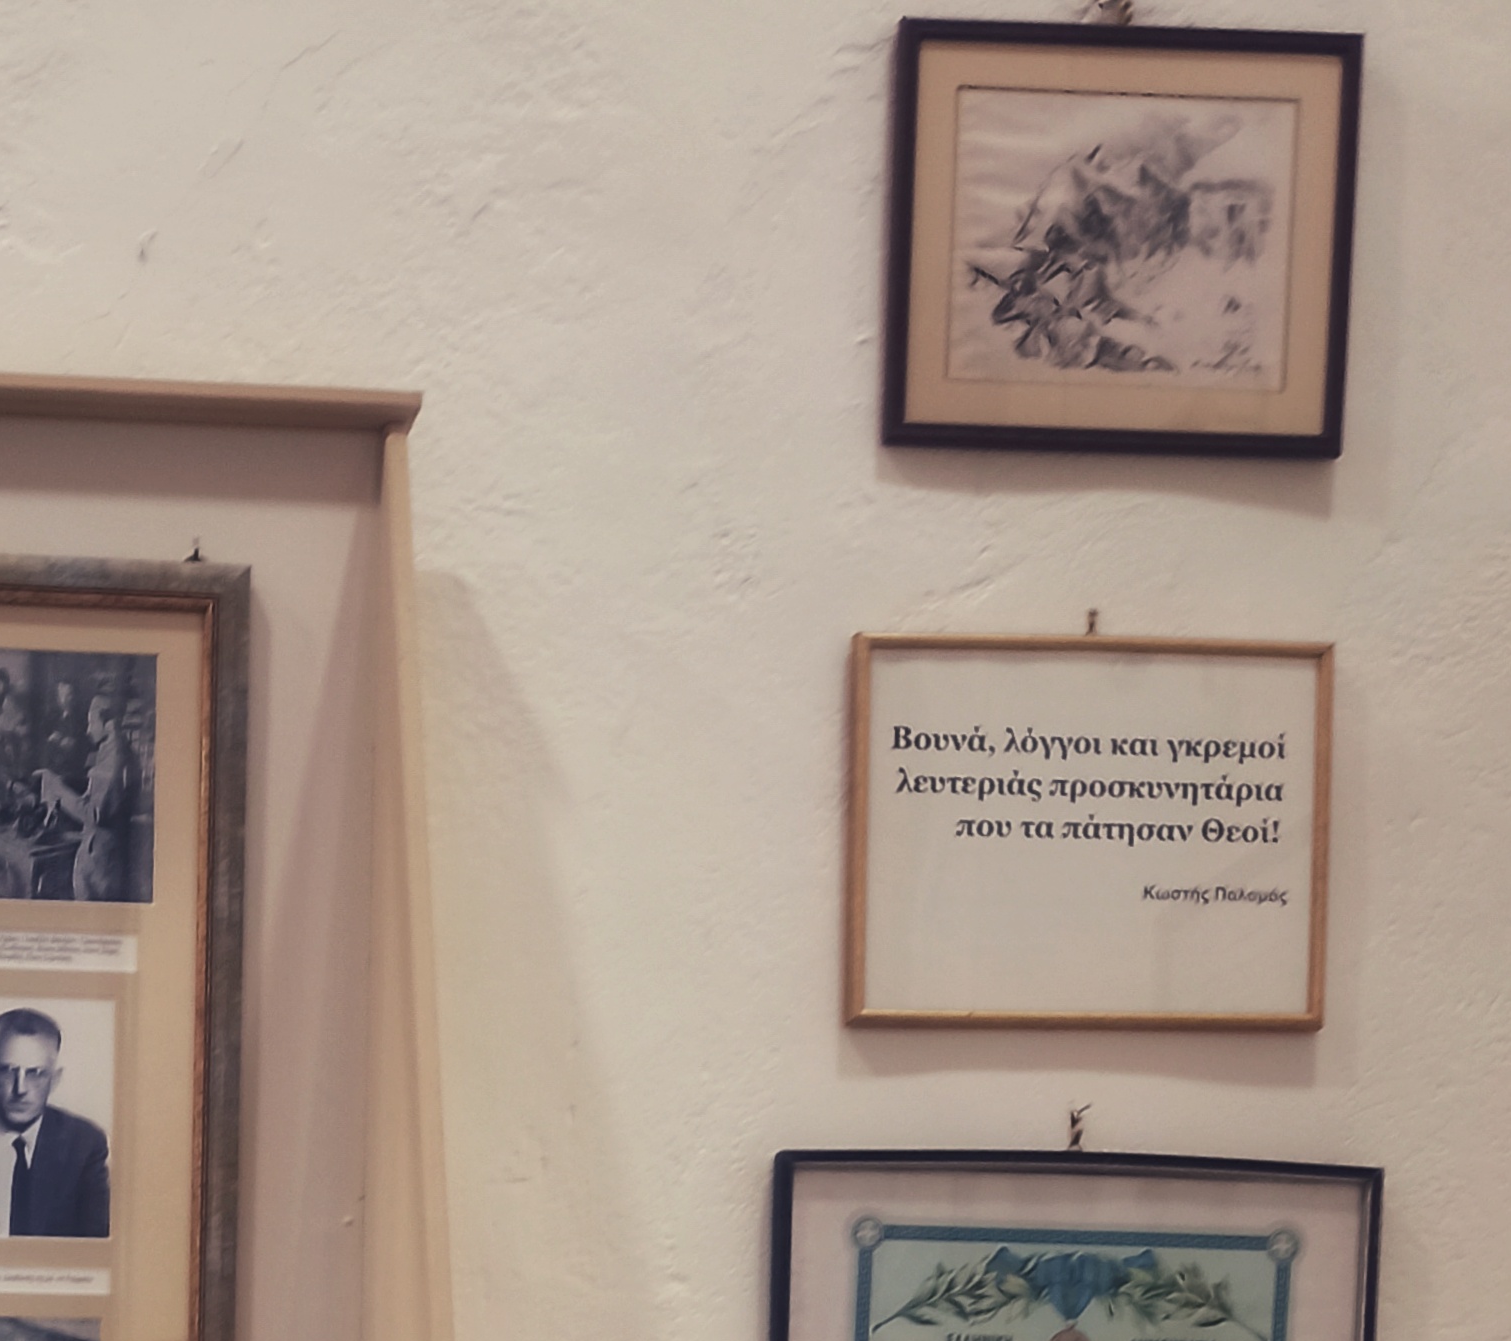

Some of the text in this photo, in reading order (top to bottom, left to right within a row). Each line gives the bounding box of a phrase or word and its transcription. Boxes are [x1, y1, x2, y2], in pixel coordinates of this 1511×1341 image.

[891, 725, 1286, 763] Βουνά, λόγγοι και γκρεμοί
[895, 768, 1284, 805] λευτεριάς προσκυνητάρια
[954, 815, 1281, 847] που τα πάτησαν Θεοί!
[1142, 885, 1289, 907] Κωστής Παλαμάς
